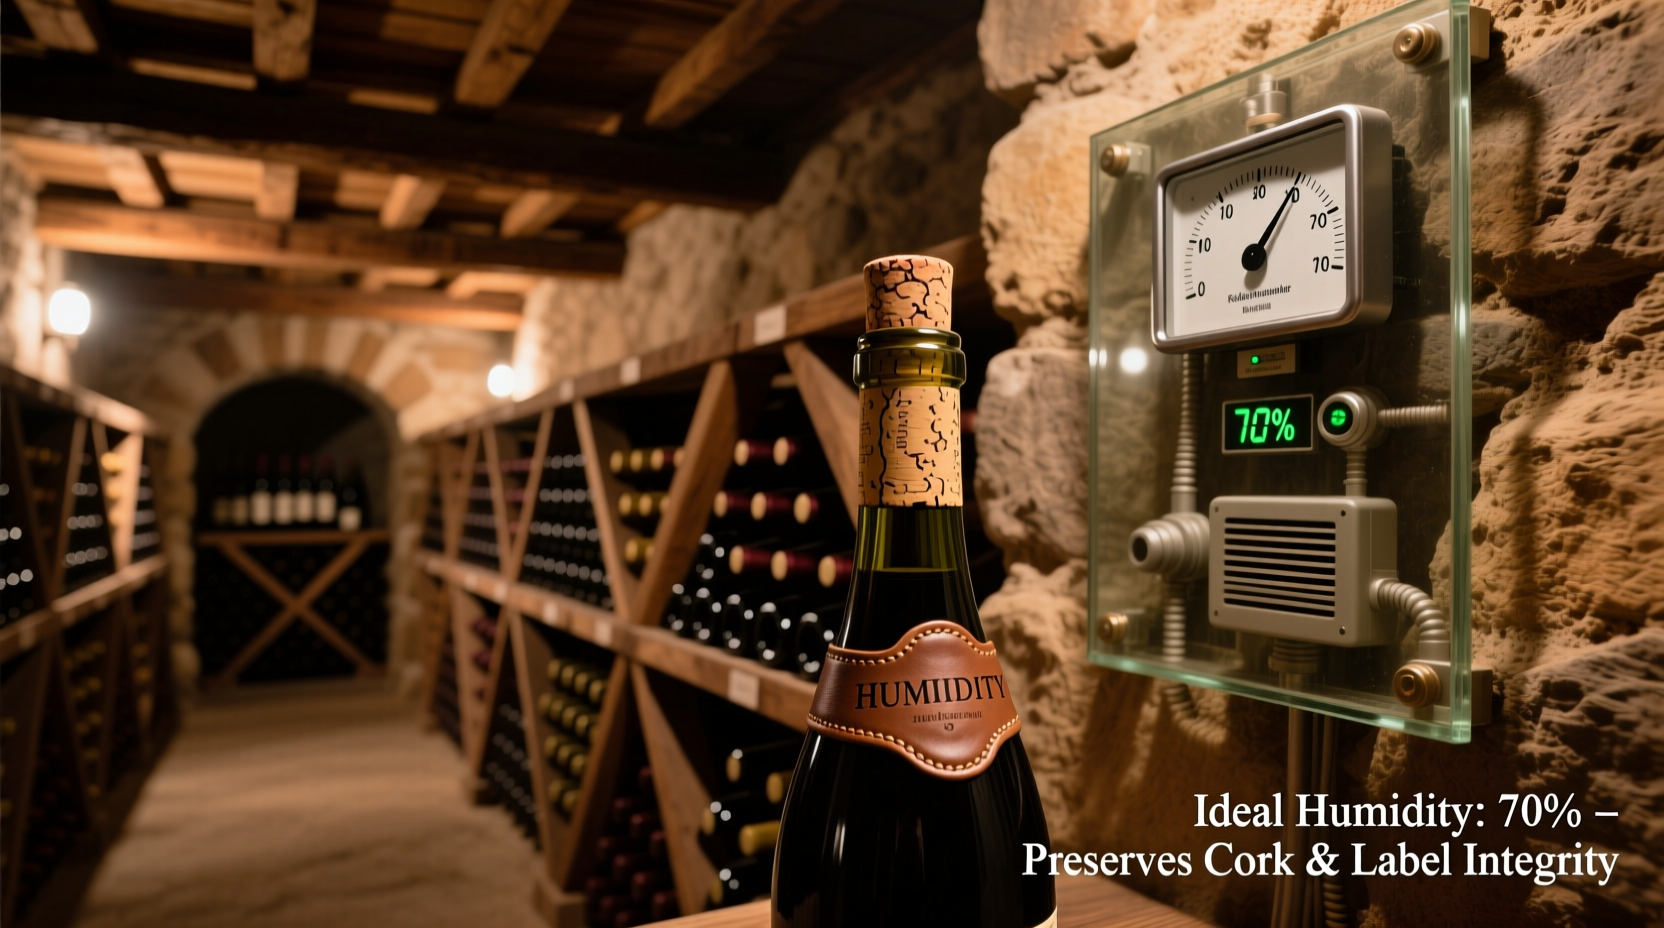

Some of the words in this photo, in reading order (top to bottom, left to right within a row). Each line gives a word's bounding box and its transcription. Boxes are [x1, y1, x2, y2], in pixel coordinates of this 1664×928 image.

[1219, 203, 1234, 220] 10
[1309, 212, 1327, 230] 70
[1198, 281, 1206, 297] 0
[1235, 407, 1295, 443] 70%
[855, 674, 1005, 710] HUMIIDITY
